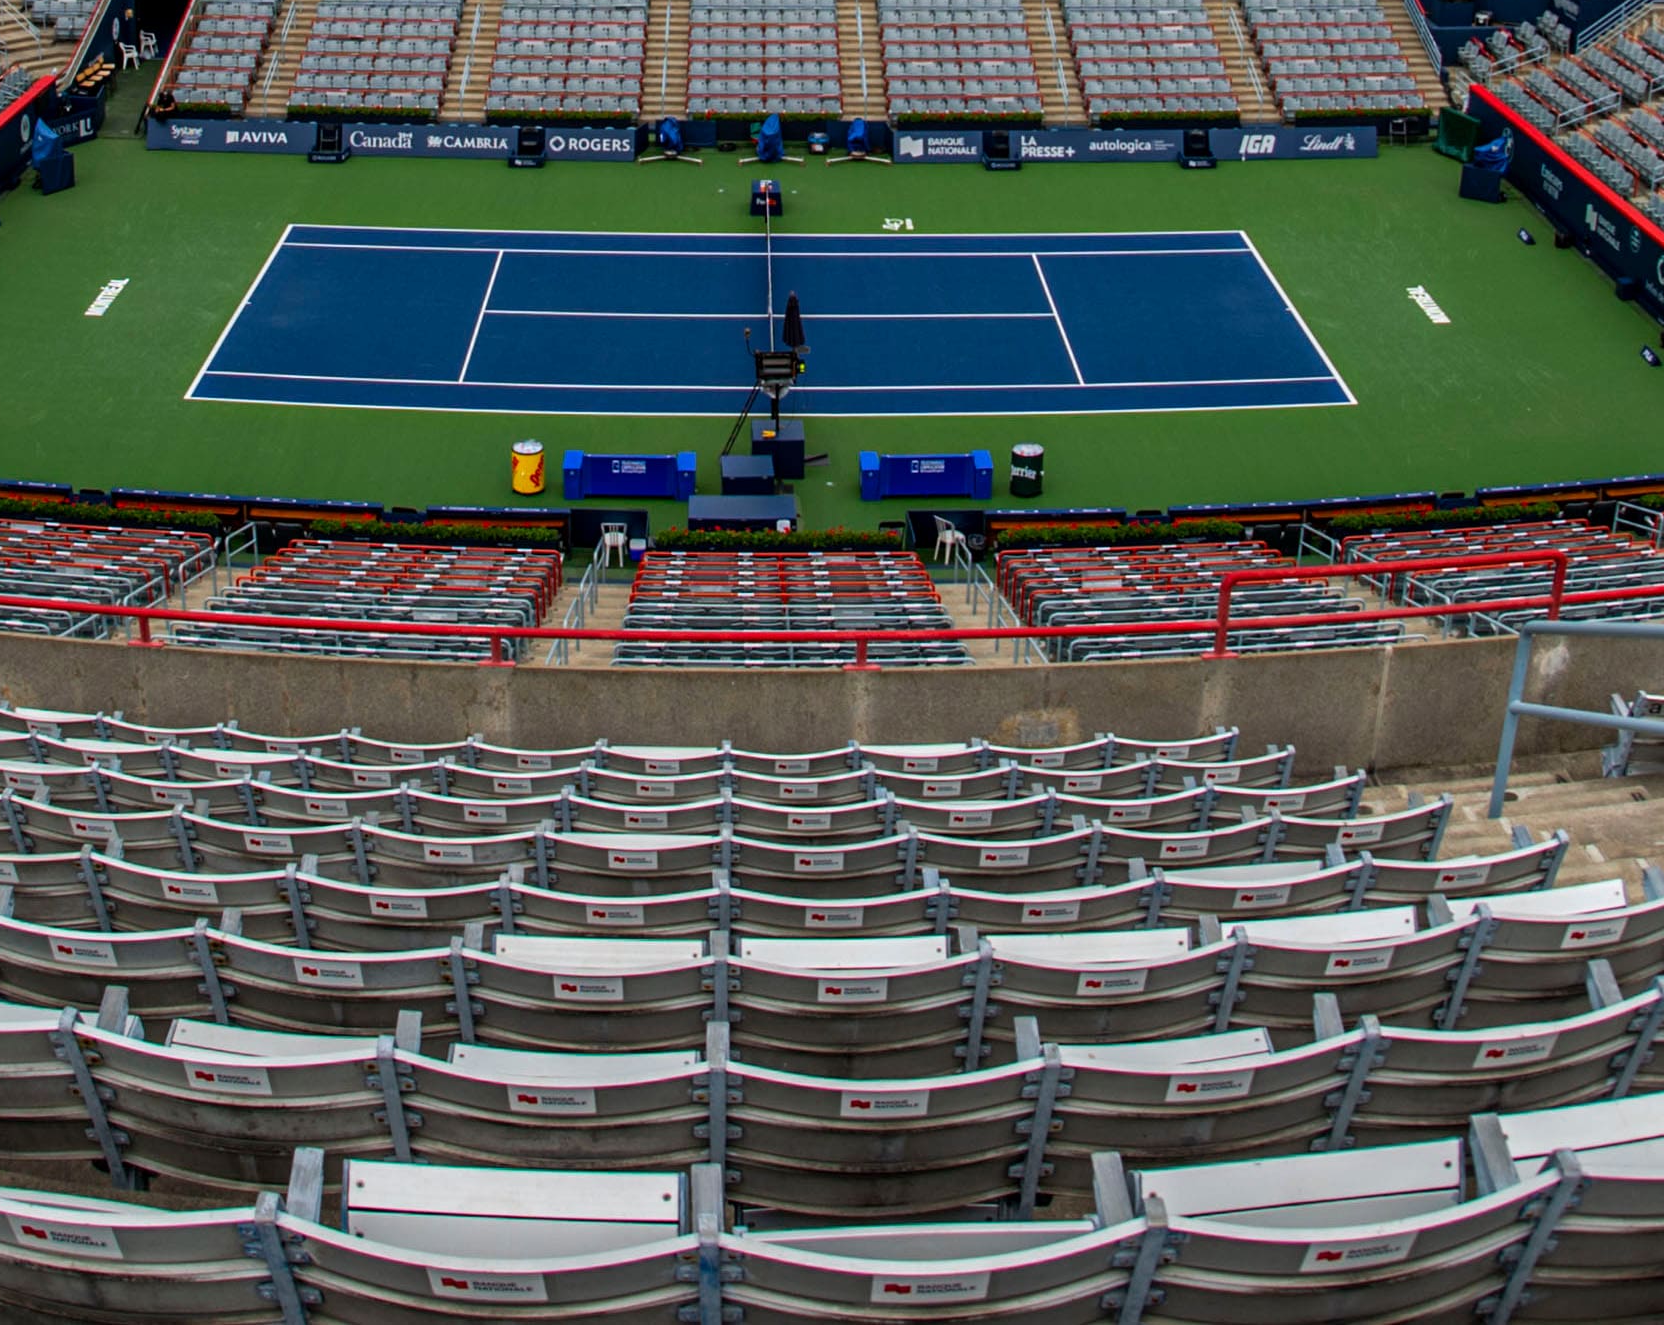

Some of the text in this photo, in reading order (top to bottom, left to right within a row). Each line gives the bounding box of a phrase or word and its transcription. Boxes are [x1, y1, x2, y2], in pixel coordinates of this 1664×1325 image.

[241, 132, 288, 144] AVIVA
[350, 131, 413, 148] Canada
[444, 136, 508, 149] CAMBRIA
[928, 138, 965, 146] BANQUE
[1021, 136, 1037, 146] LA
[1300, 134, 1346, 150] Lindt
[568, 138, 630, 151] ROGERS
[1089, 139, 1152, 154] autologica
[1239, 135, 1276, 154] IGA
[928, 146, 977, 155] NATIONALE
[1021, 146, 1076, 157] PRESSE+
[50, 1231, 91, 1240] BANQUE
[52, 1237, 107, 1247] NATIONALE
[916, 1286, 976, 1294] NATIONALE
